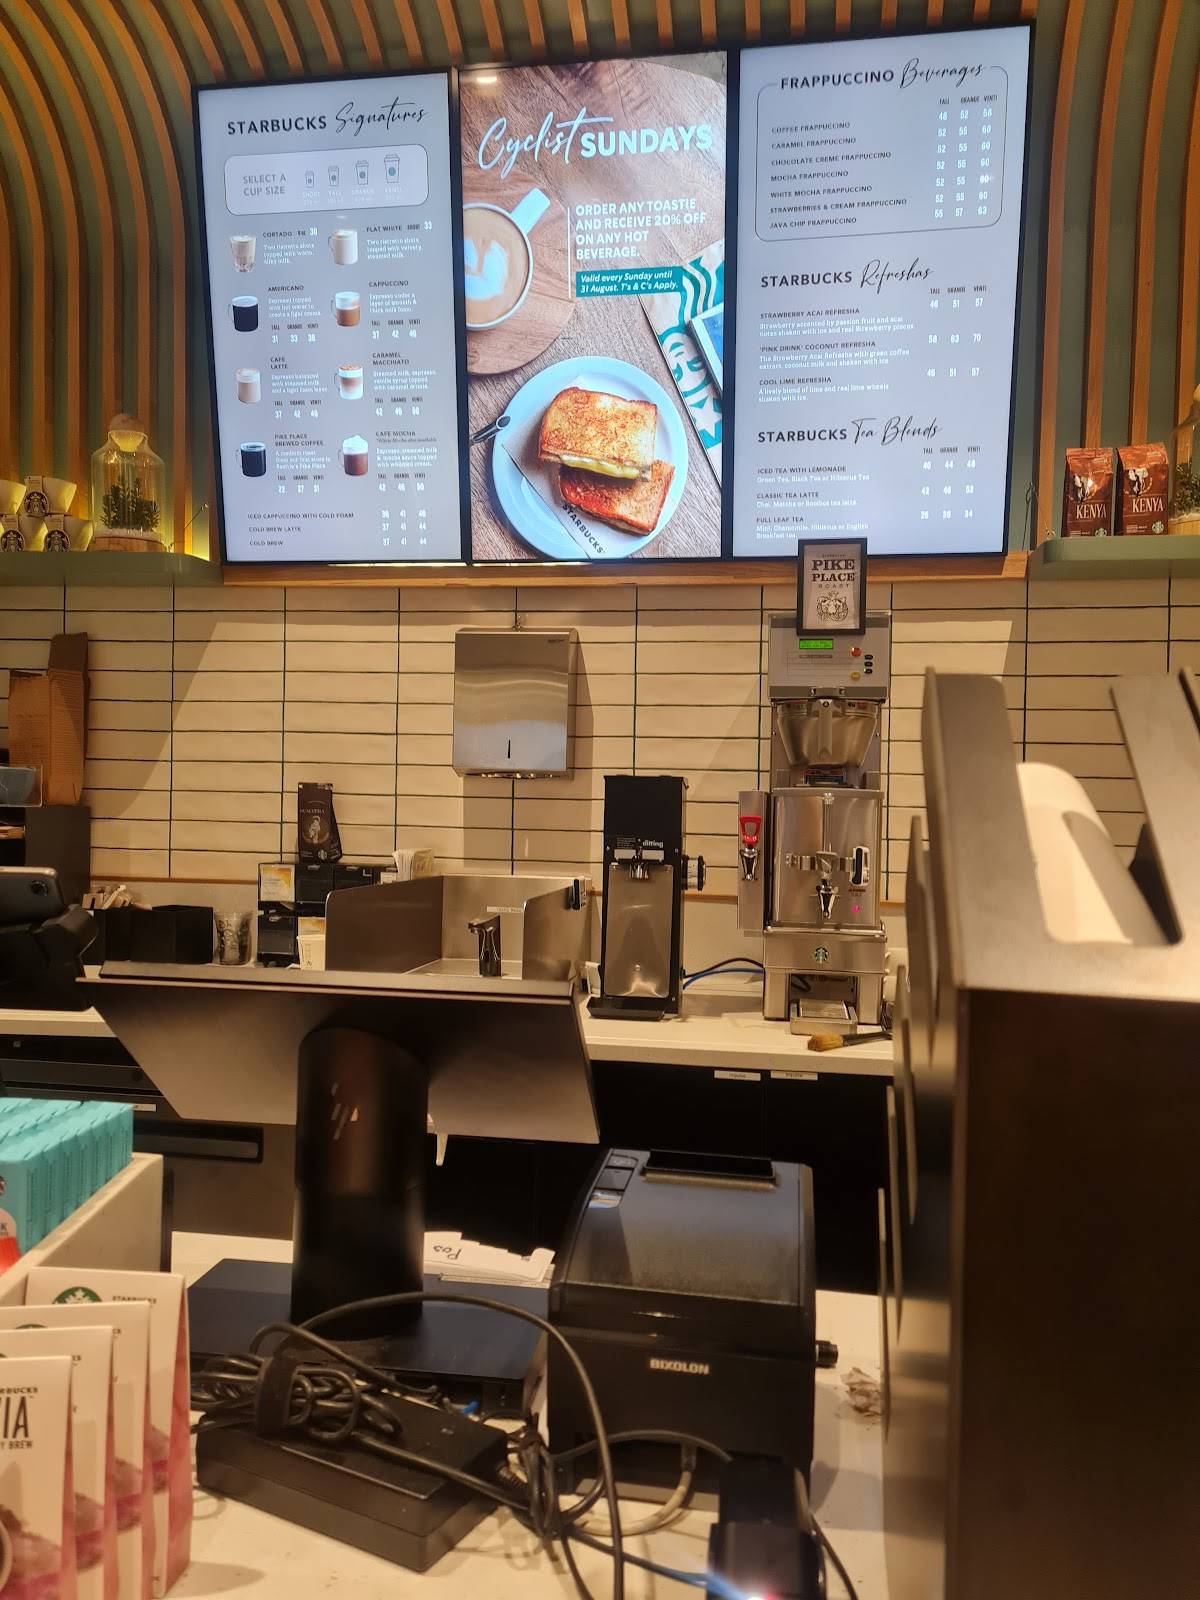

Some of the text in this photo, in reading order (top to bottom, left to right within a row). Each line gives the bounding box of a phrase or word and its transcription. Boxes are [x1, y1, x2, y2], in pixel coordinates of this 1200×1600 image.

[781, 58, 985, 90] FRAPPUCCINO Beverages
[228, 96, 428, 136] STARBUCKS Signatures
[772, 122, 850, 134] COFFEE FRAPPUCCINO
[982, 125, 991, 133] 60
[478, 107, 712, 179] Cyclist SUNDAYS
[807, 138, 856, 147] FRAPPUCCINO
[959, 143, 967, 152] 55
[772, 158, 813, 166] CHOCOLATE
[842, 152, 891, 160] FRAPPUCCINO
[243, 173, 286, 184] SELECT A
[800, 171, 848, 179] FRAPPUCCINO
[244, 186, 285, 196] CUP SIZE
[823, 186, 872, 194] FRAPPUCCINO
[576, 199, 696, 216] ORDER ANY TOASTIE
[770, 205, 820, 213] STRAWBERRIES
[857, 199, 907, 207] FRAPPUCCINO
[424, 221, 432, 230] 33
[576, 212, 706, 231] AND RECEIVE 20% OFF
[807, 218, 856, 226] FRAPPUCCINO
[310, 228, 317, 236] 30
[576, 231, 649, 245] ON ANY HOT
[576, 246, 640, 260] BEVERAGE.
[581, 270, 673, 283] Valid every Sunday until
[761, 257, 935, 294] STARBUCKS Refreshas
[581, 285, 589, 293] 31
[591, 284, 619, 293] August.
[621, 283, 631, 291] T's
[641, 282, 652, 290] C's
[654, 281, 678, 290] Apply.
[825, 308, 860, 316] REFRESHA
[973, 333, 981, 342] 70
[758, 416, 943, 446] STARBUCKS Tea Blends
[945, 460, 953, 469] 44
[1076, 504, 1107, 519] KENYA
[1132, 498, 1164, 513] KENYA
[563, 503, 606, 554] STARBUCKS
[812, 559, 855, 571] PIKE
[811, 572, 855, 582] PLACE
[650, 1358, 709, 1375] BIXOLON
